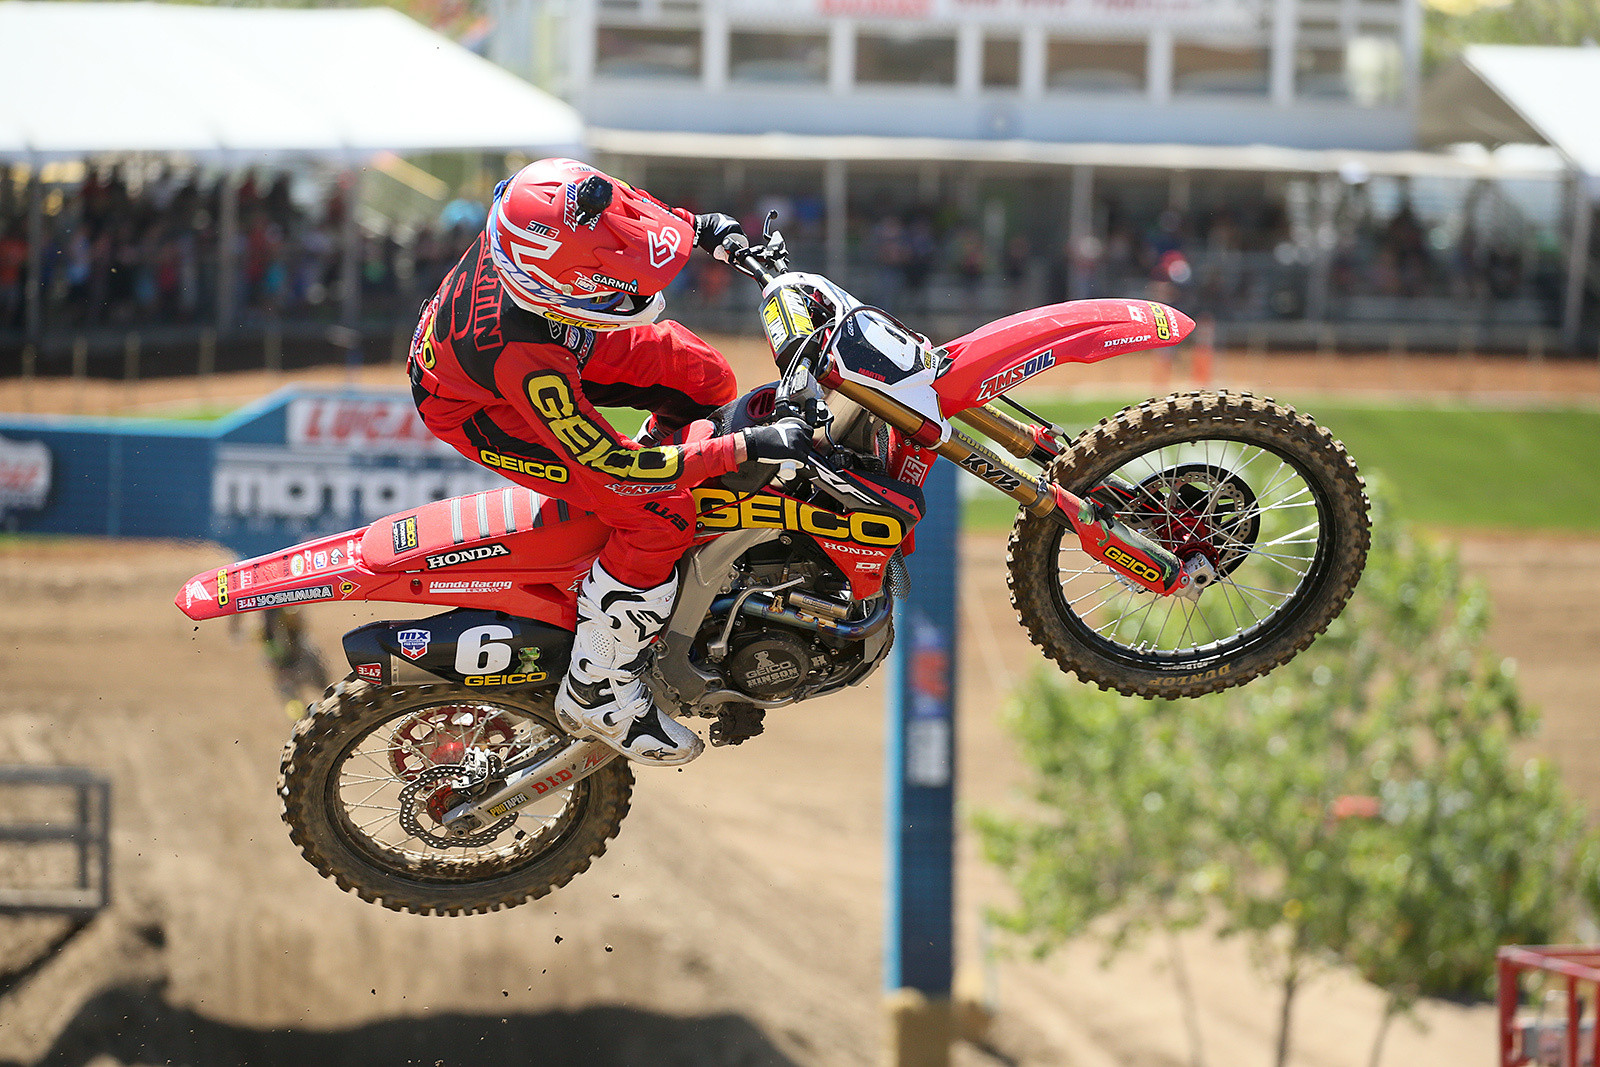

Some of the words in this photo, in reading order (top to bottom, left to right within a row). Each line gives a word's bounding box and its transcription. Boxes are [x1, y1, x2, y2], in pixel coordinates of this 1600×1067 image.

[591, 273, 638, 293] GARMIN
[544, 311, 620, 330] GEICO
[1103, 334, 1152, 348] DUNLOP
[976, 349, 1056, 402] AMSOIL
[527, 374, 680, 479] GEICO
[480, 449, 568, 484] GEICO
[960, 451, 1021, 492] KYB
[604, 483, 677, 497] AMSOIL
[692, 487, 903, 546] GEICO
[427, 544, 510, 570] HONDA
[823, 541, 887, 557] HONDA
[1104, 547, 1160, 583] GEICO
[256, 586, 332, 607] YOSHIMURA
[470, 580, 513, 590] Racing
[454, 624, 514, 676] 6
[464, 671, 549, 687] GEICO
[745, 660, 792, 680] GEICO
[746, 666, 800, 689] HINSON
[1149, 662, 1231, 687] DUNLOP
[489, 792, 529, 818] PROTAPER
